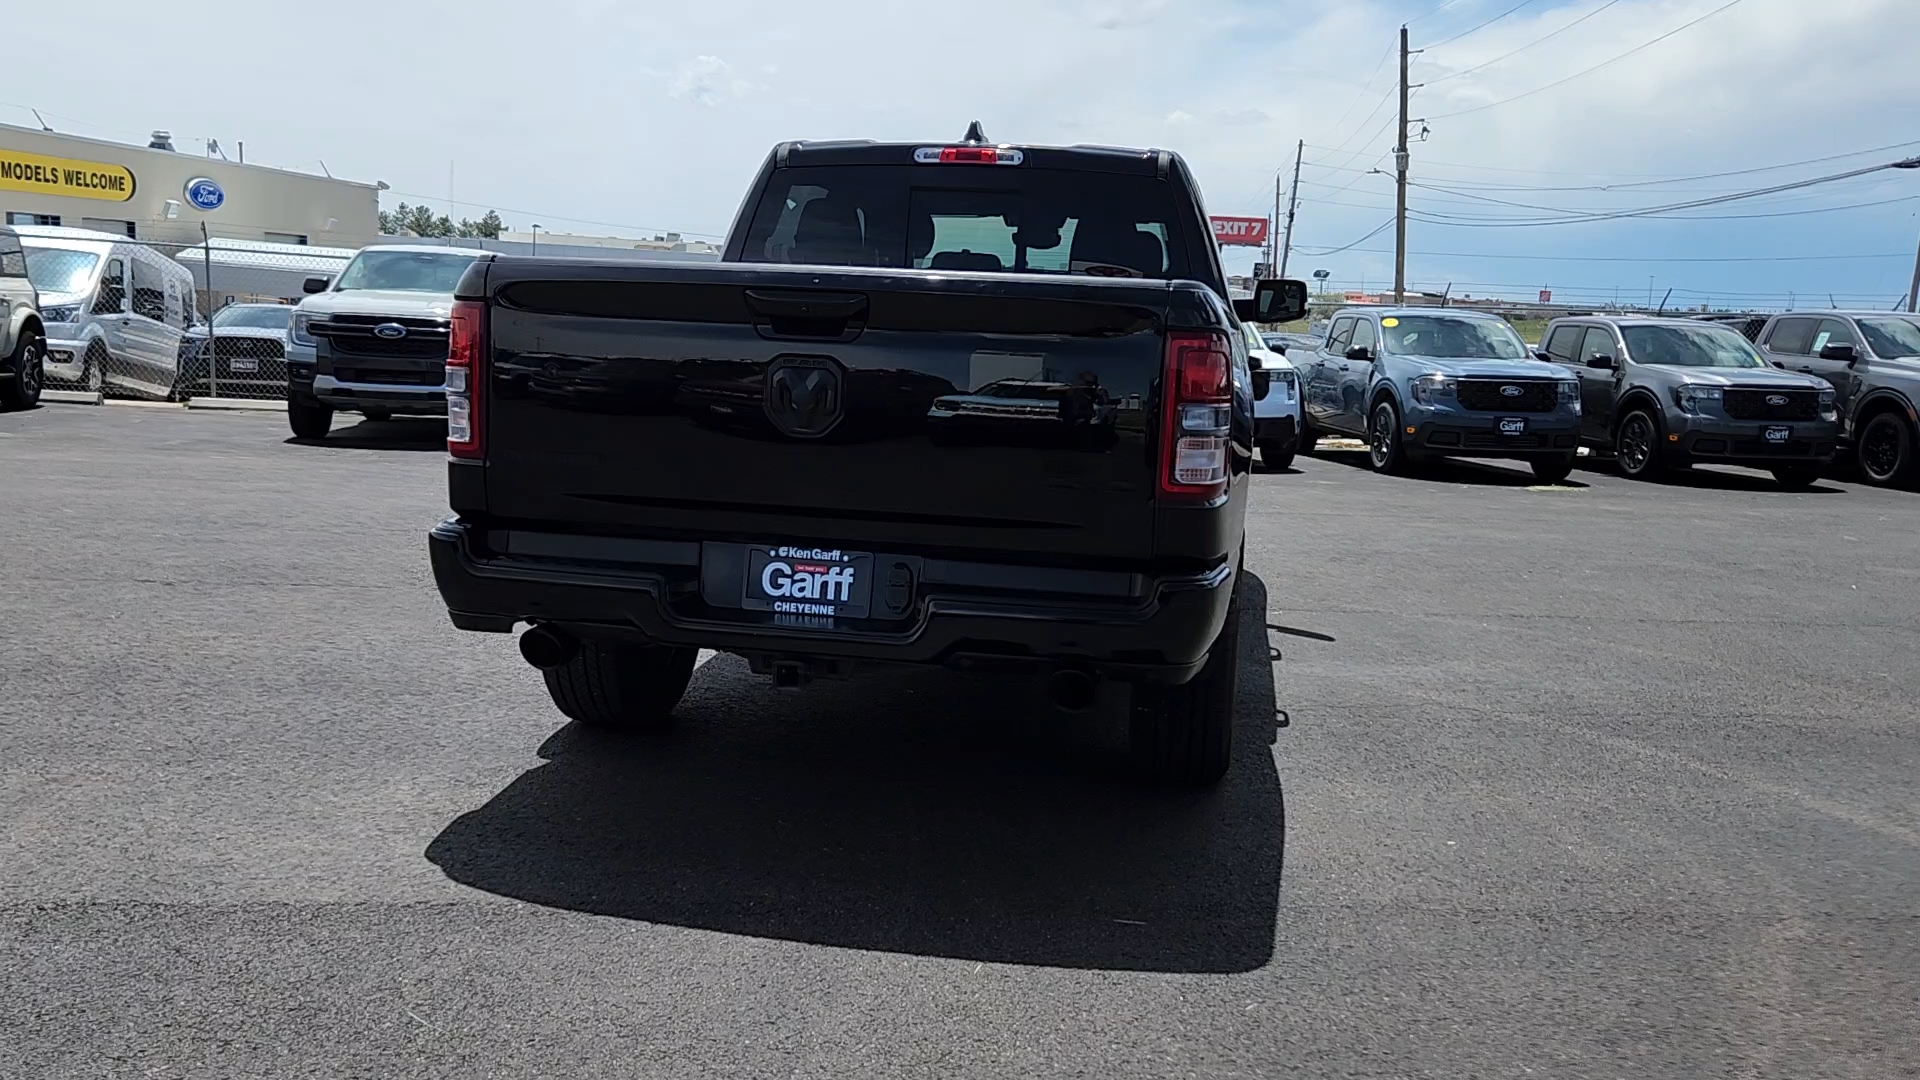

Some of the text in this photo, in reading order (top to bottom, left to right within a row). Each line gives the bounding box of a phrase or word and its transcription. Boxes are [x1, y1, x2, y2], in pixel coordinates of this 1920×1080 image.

[1, 161, 126, 192] MODELS WELCOME
[197, 185, 219, 205] Ford
[1212, 220, 1262, 236] EXIT 7
[1500, 421, 1525, 432] Garff
[1765, 429, 1790, 440] Garff
[788, 547, 841, 561] Ken Garff
[762, 562, 855, 602] Garff
[774, 601, 835, 615] CHEYENNE
